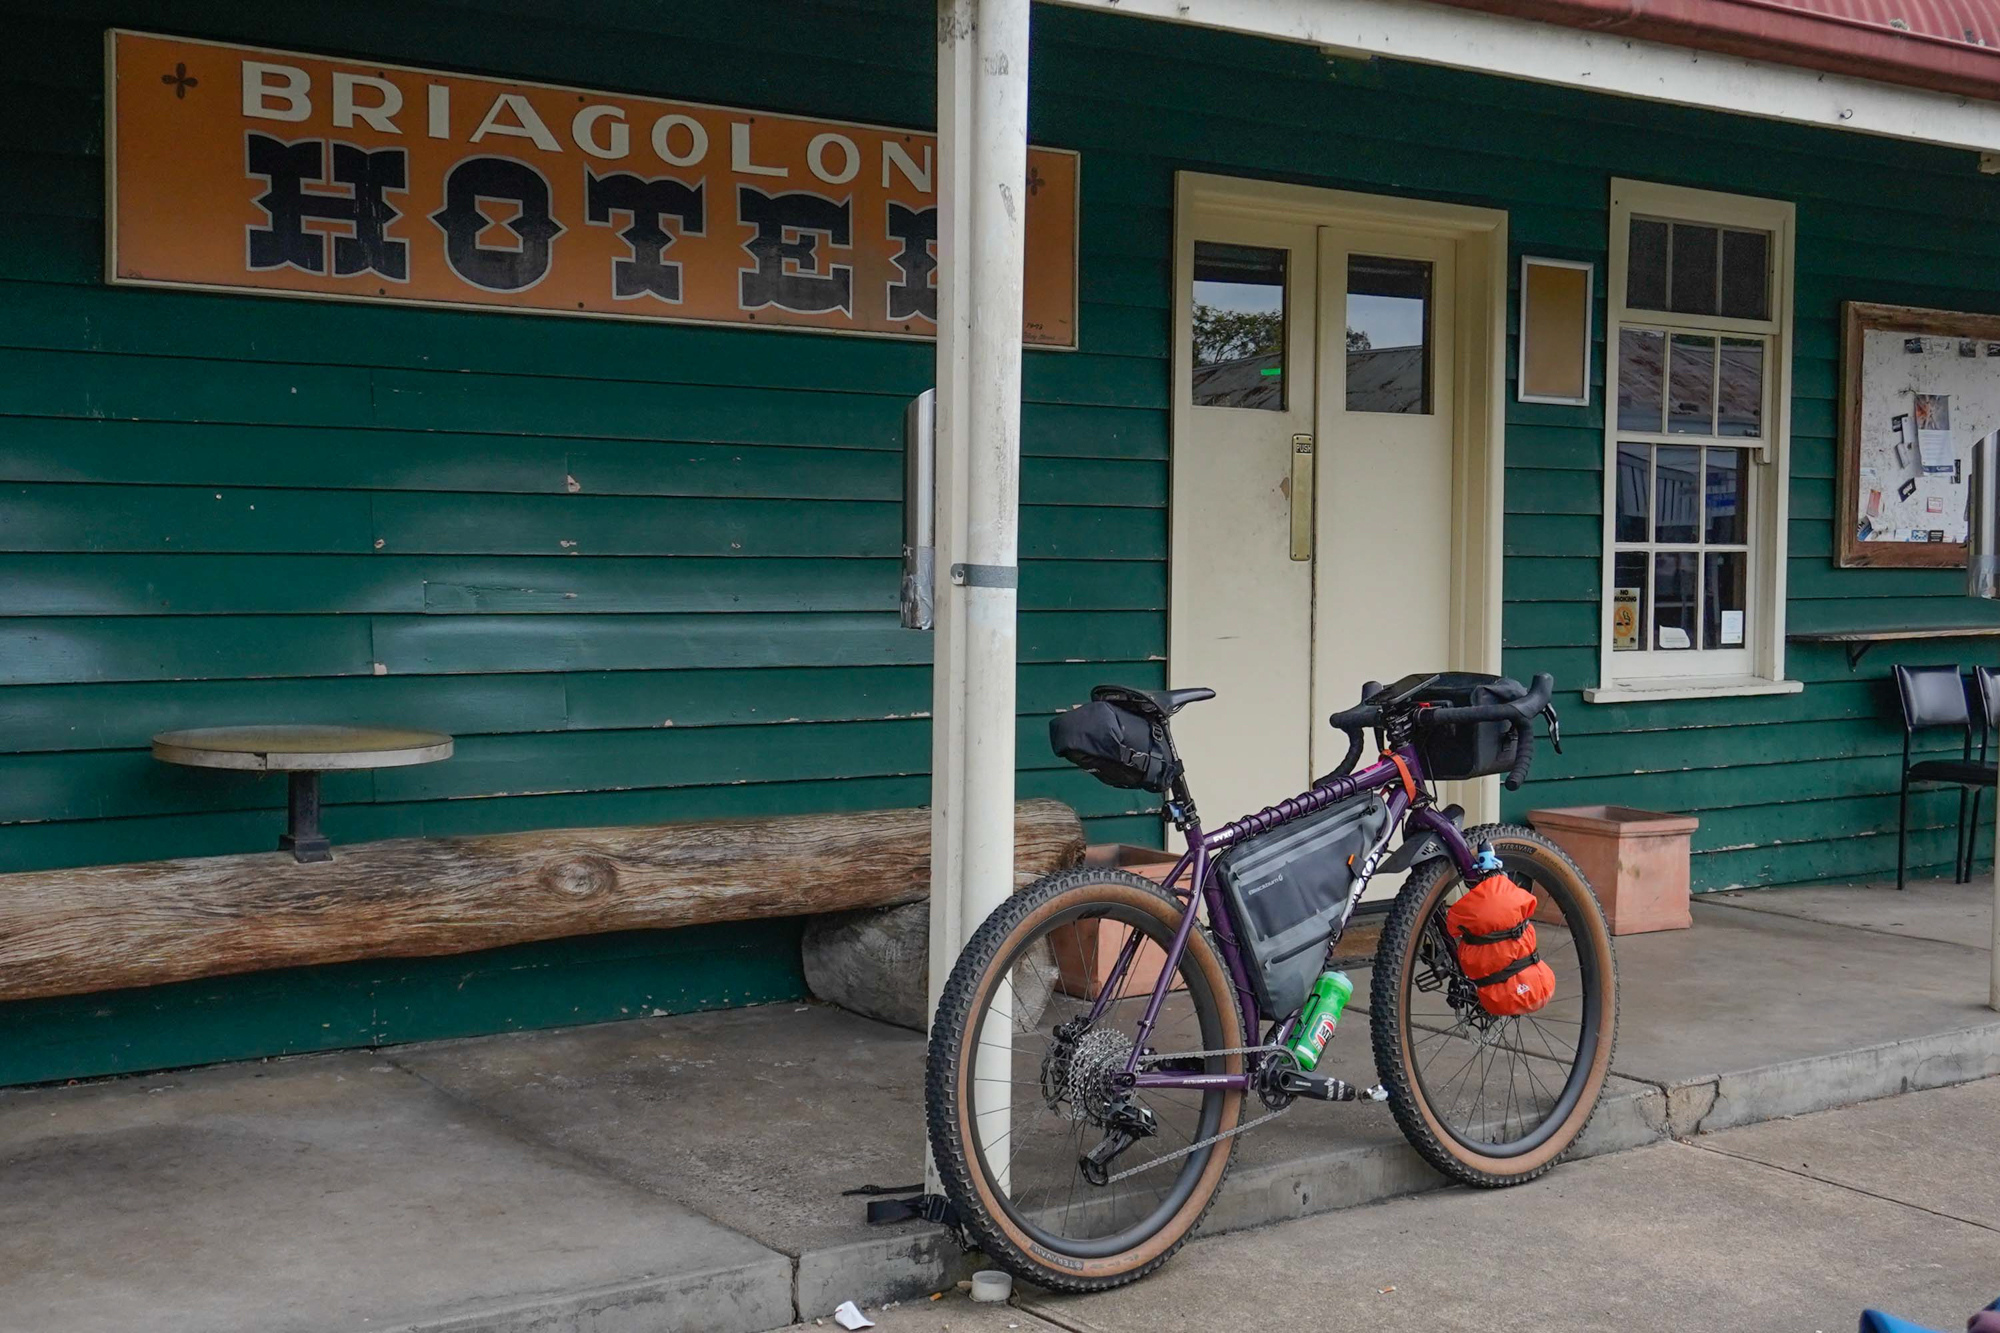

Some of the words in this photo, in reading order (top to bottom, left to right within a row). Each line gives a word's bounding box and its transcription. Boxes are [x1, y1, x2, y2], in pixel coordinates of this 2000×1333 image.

[242, 59, 932, 194] BRIAGOLON
[1296, 444, 1312, 453] PUSH
[1502, 844, 1533, 854] TERAVAIL
[1033, 1245, 1076, 1269] TERAVAIL
